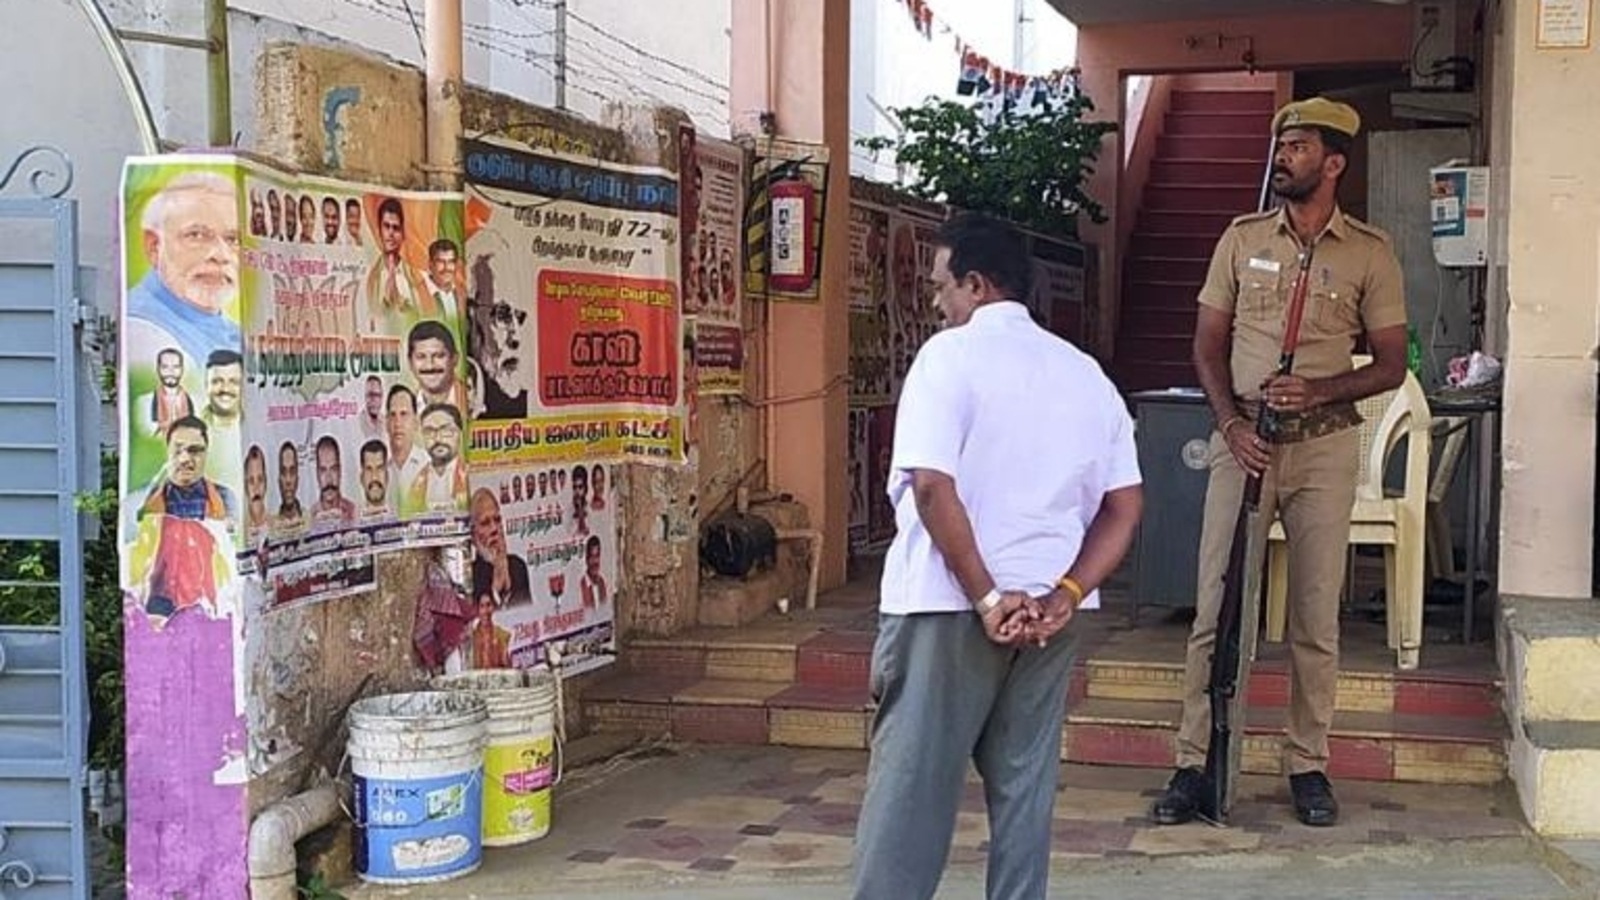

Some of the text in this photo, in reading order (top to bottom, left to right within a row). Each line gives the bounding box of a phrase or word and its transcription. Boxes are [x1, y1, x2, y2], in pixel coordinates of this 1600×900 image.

[469, 417, 673, 453] பாரதிய ஜனதா கட்சி
